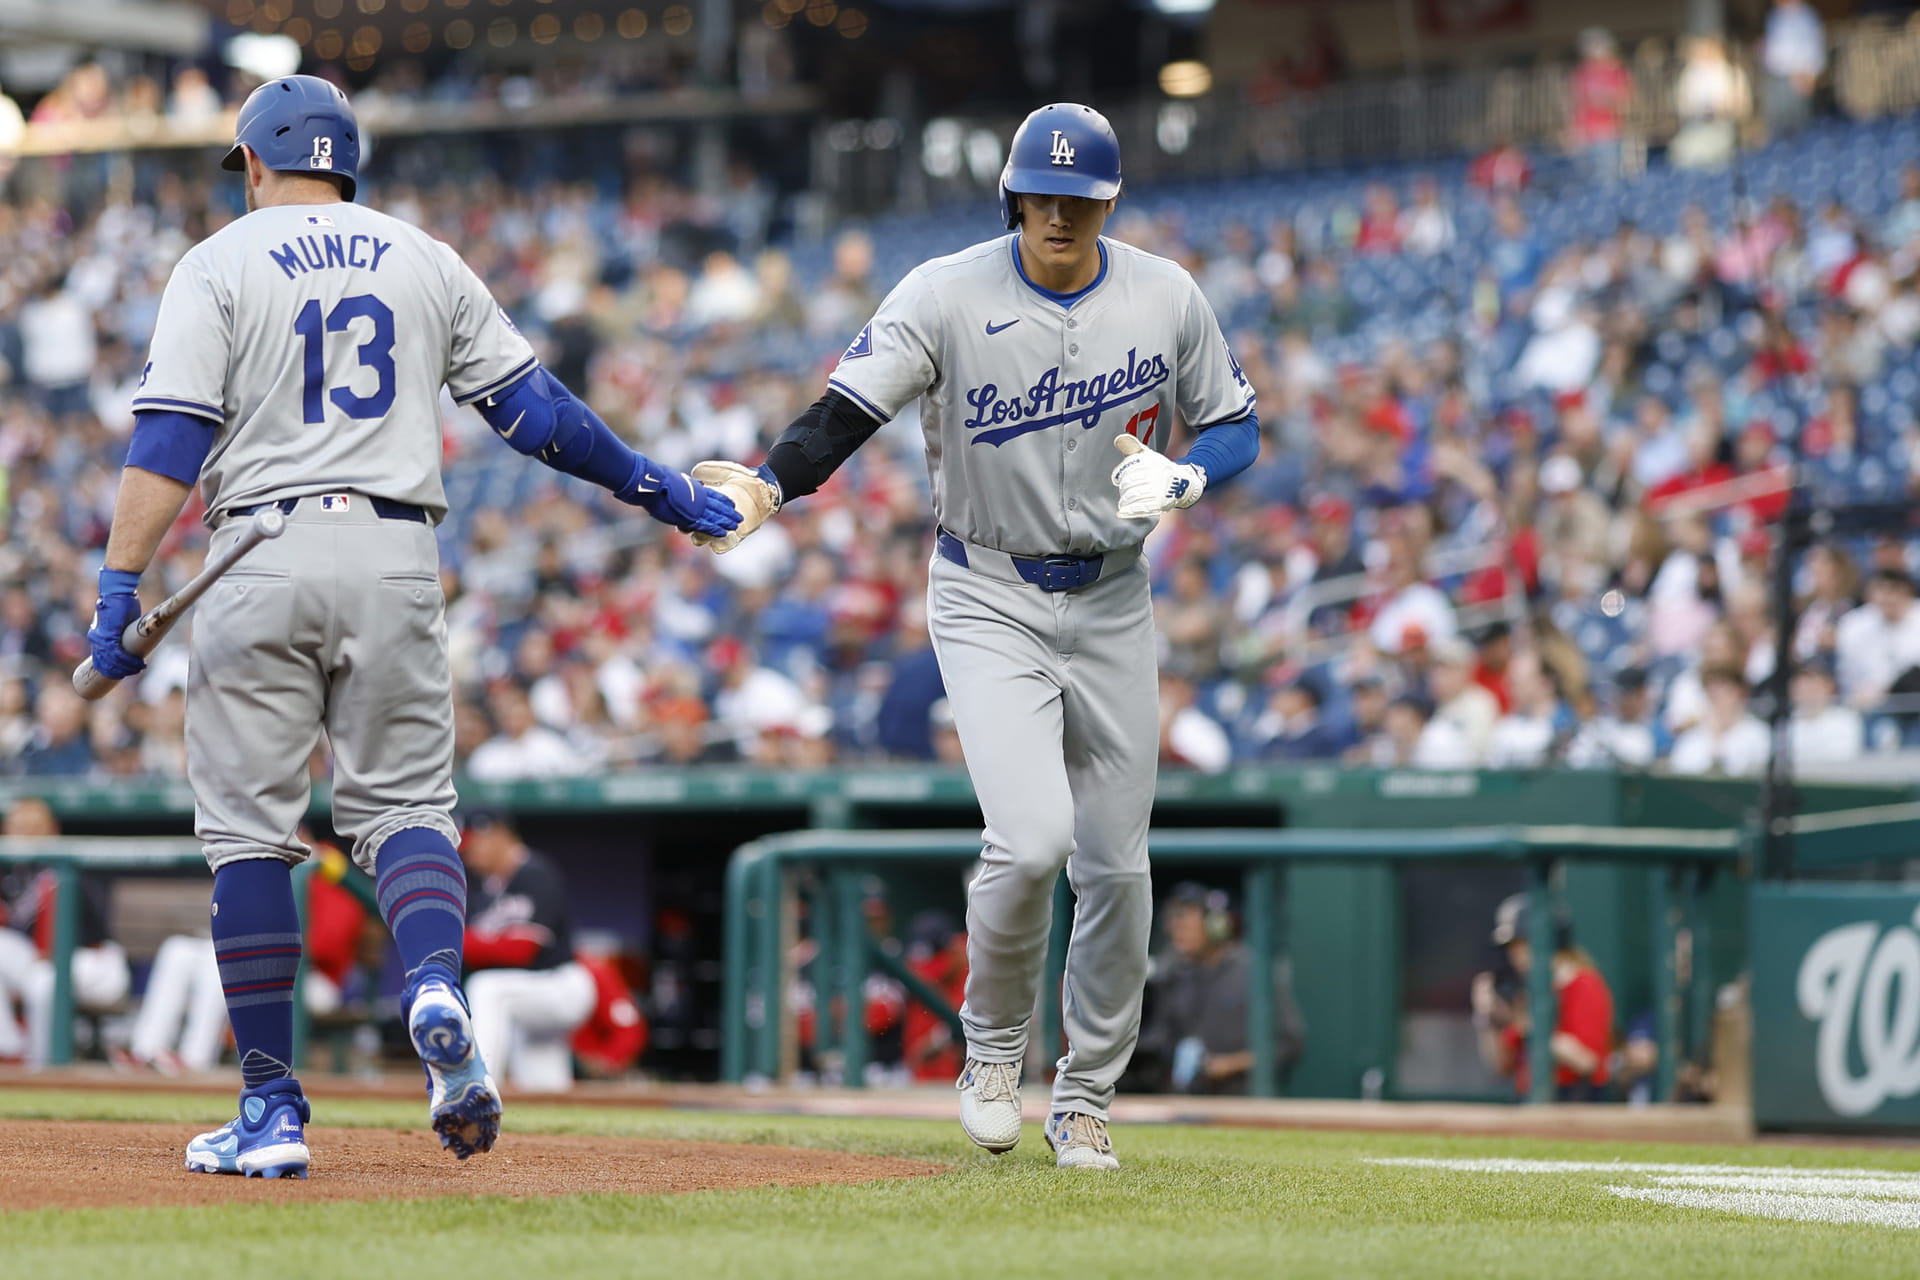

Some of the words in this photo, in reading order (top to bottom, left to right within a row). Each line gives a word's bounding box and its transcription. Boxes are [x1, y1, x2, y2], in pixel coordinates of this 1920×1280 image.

[312, 136, 332, 156] 13
[1050, 130, 1075, 165] LA
[268, 234, 392, 280] MUNCY
[294, 294, 396, 424] 13
[1024, 347, 1170, 429] Angeles
